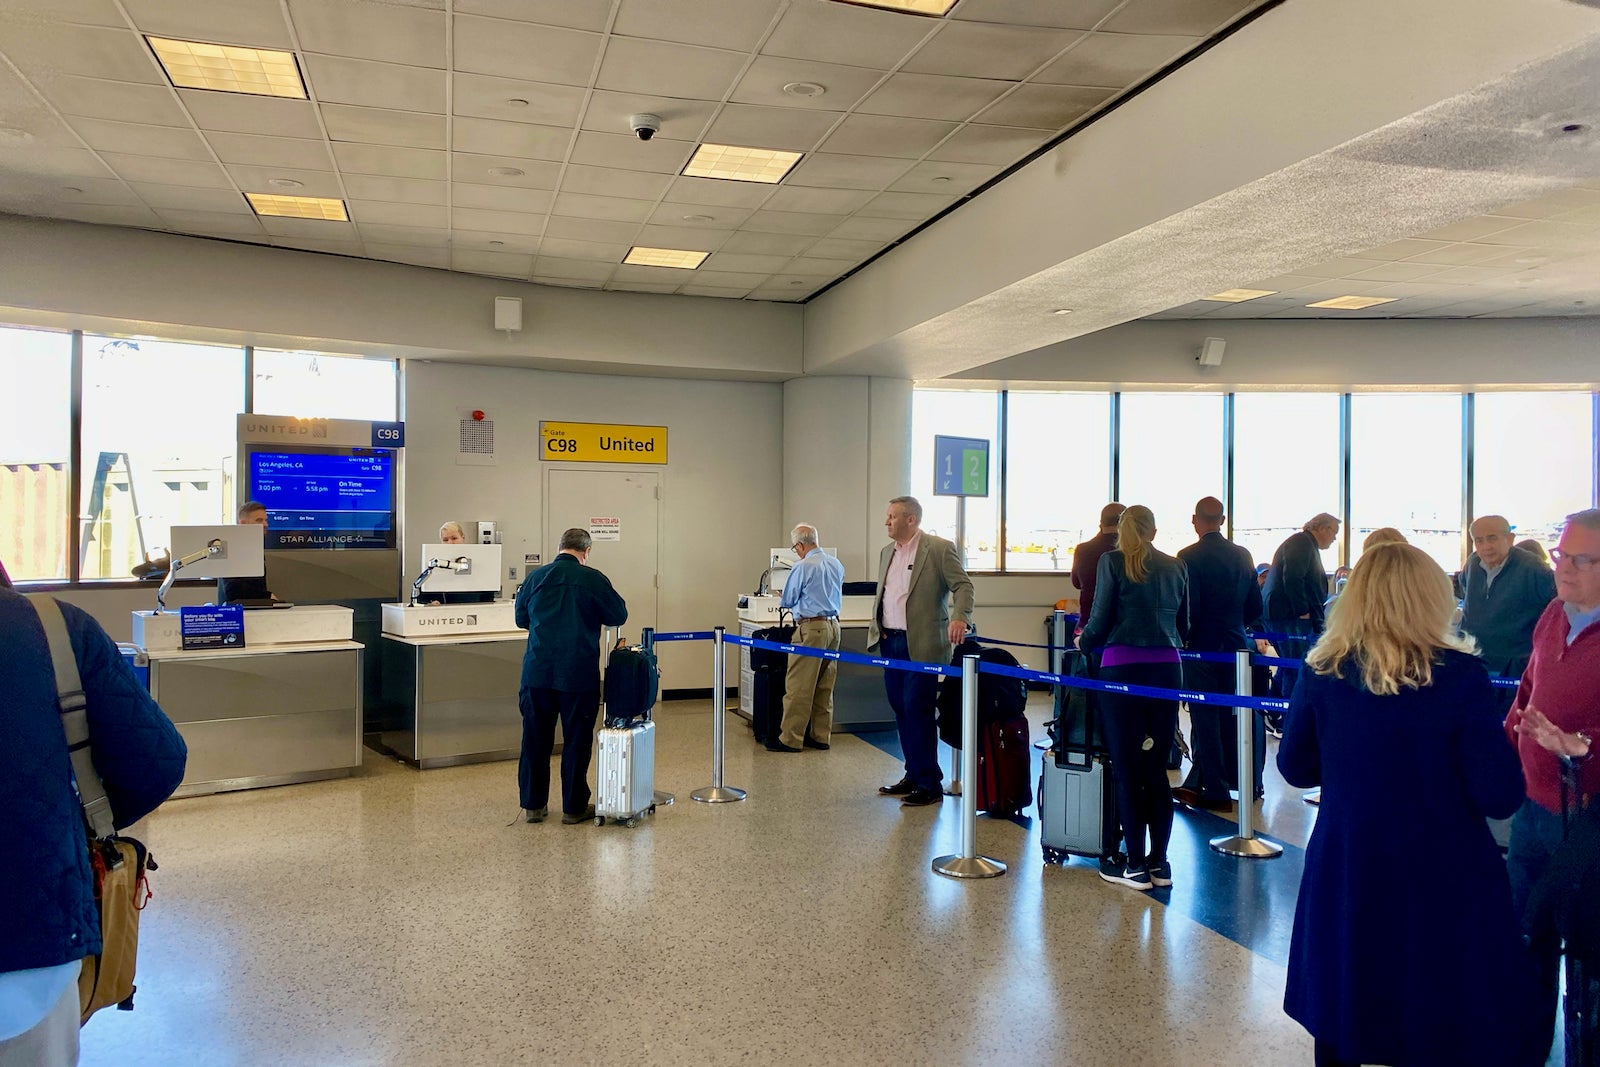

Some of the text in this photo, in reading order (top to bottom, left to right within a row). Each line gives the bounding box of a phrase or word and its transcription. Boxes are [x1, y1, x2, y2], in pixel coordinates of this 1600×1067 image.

[246, 424, 309, 435] UNITED
[377, 428, 400, 440] C98
[547, 436, 654, 453] C98 United
[944, 454, 953, 476] 1
[970, 455, 979, 477] 2
[418, 618, 464, 626] UNITED
